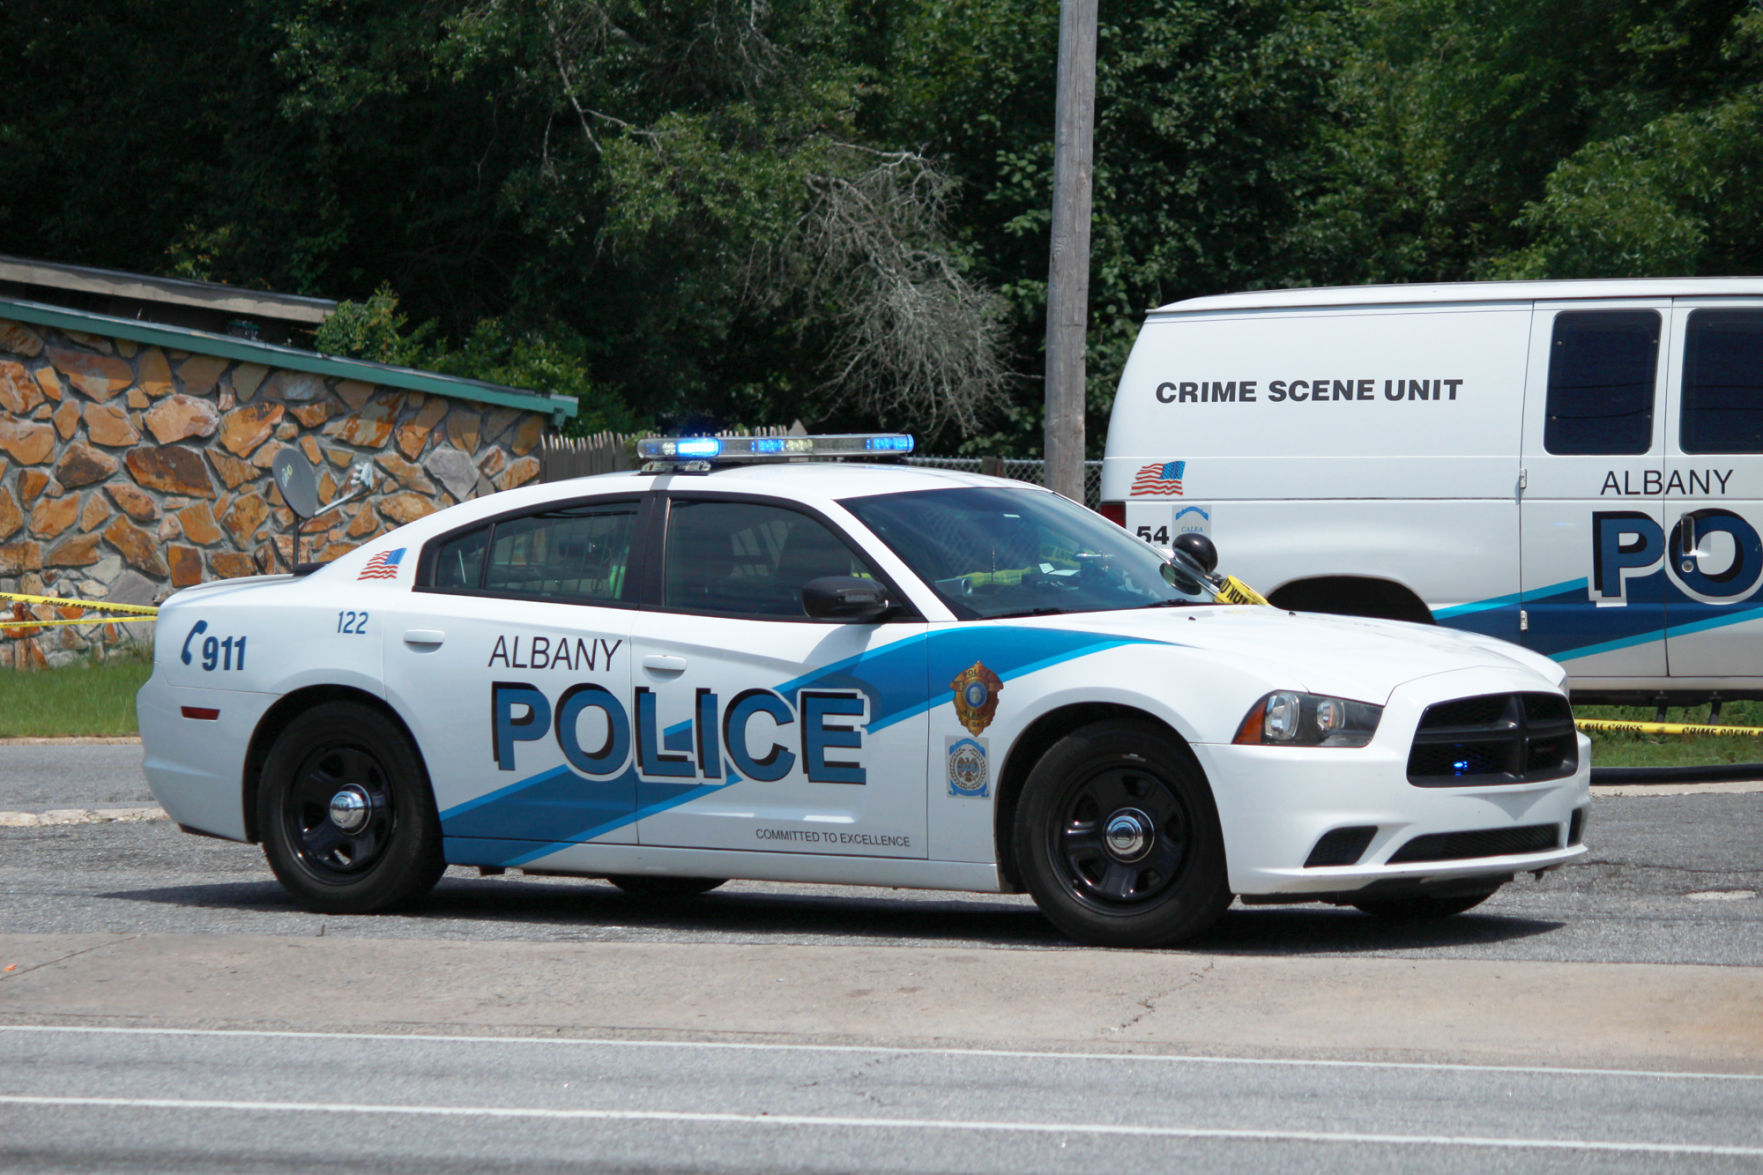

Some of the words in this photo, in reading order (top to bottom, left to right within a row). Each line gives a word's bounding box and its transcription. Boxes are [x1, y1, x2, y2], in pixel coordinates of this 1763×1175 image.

[1155, 380, 1257, 404] CRIME
[1268, 379, 1375, 403] SCENE
[1384, 378, 1463, 402] UNIT
[1600, 469, 1734, 496] ALBANY
[1136, 525, 1169, 545] 54
[337, 611, 369, 635] 122
[202, 636, 247, 672] 911
[487, 635, 623, 672] ALBANY
[490, 681, 868, 787] POLICE
[755, 828, 821, 843] COMMITTED
[822, 832, 838, 843] TO
[840, 832, 911, 848] EXCELLENCE
